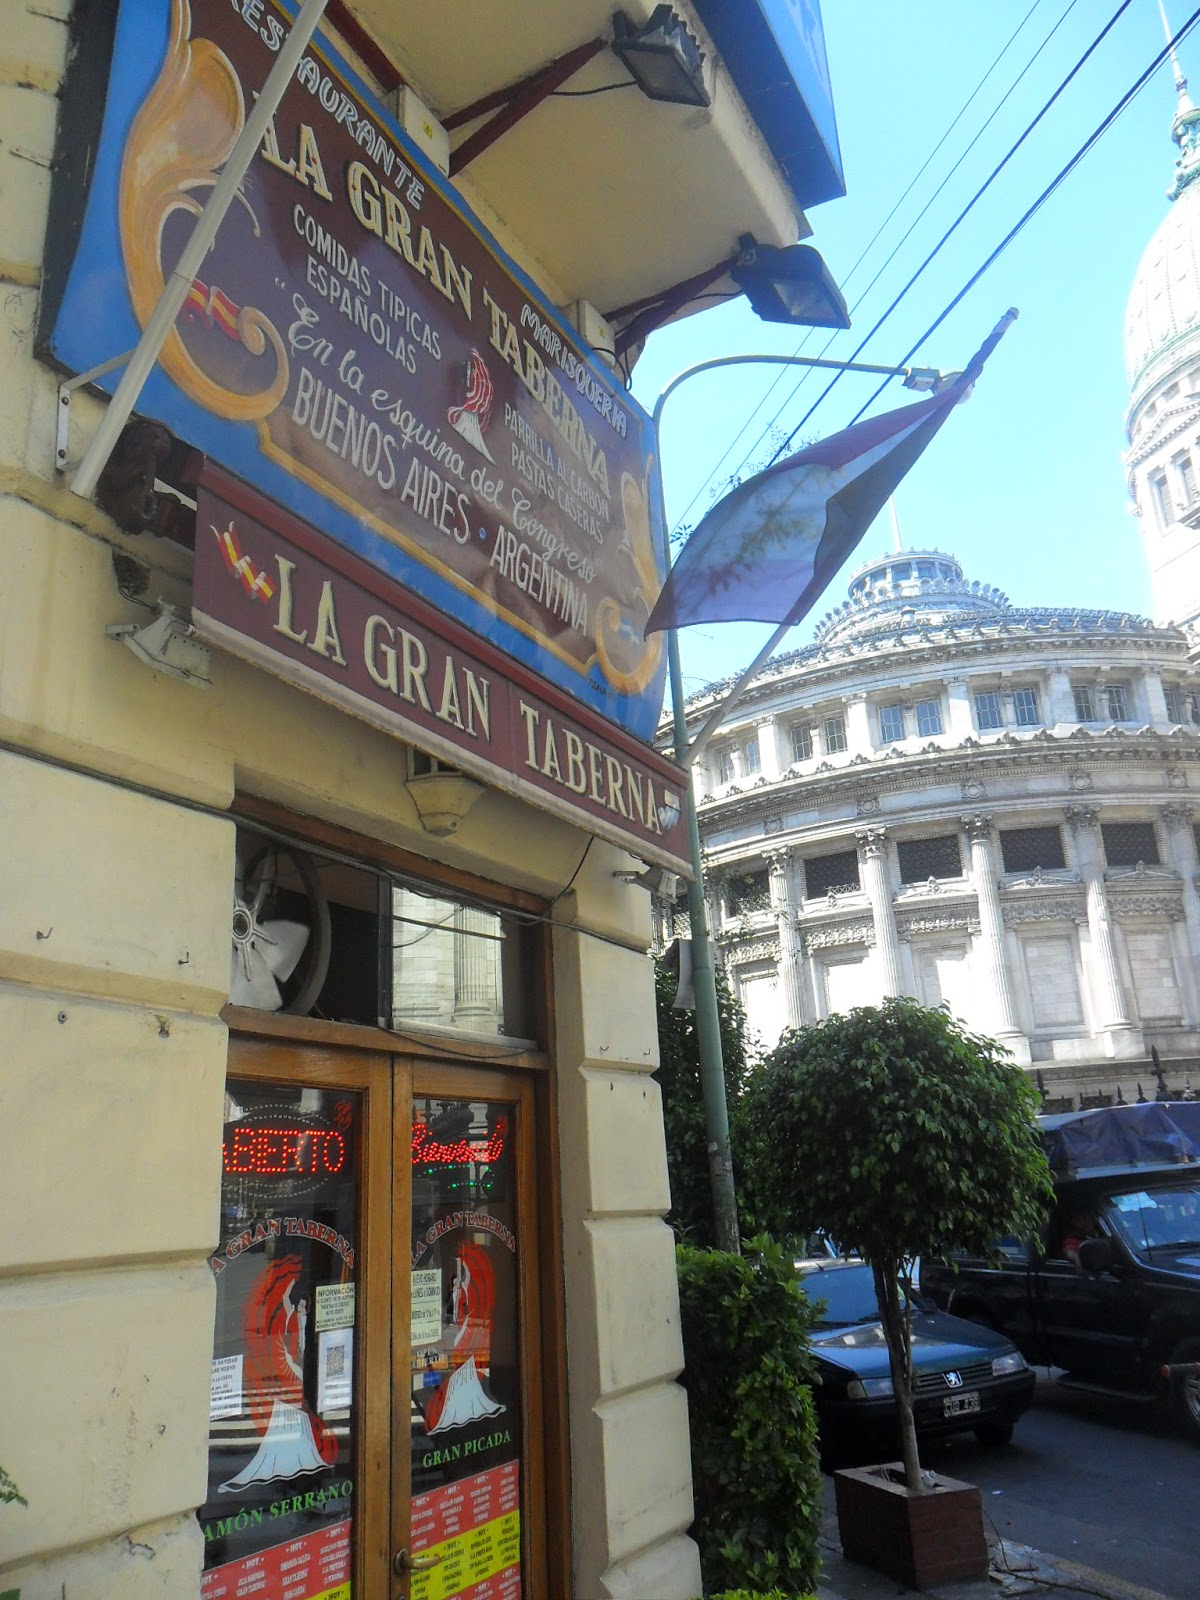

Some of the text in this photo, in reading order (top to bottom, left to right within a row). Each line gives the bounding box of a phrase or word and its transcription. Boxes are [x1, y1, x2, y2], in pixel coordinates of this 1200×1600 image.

[294, 203, 442, 361] COMIDAS TIPICAS
[306, 254, 418, 375] ESPAÑOLAS
[348, 160, 473, 321] GRAN
[483, 286, 611, 500] TABERNA
[338, 350, 363, 396] la
[371, 389, 466, 482] esquina
[470, 462, 504, 511] del
[511, 487, 596, 585] Congreso
[504, 402, 554, 472] PARRILLA
[557, 457, 569, 486] AL
[511, 442, 603, 545] PASTAS CASERAS
[293, 367, 588, 637] BUENOS AIRES ARGENTINA
[273, 554, 663, 837] LA GRAN TABERNA
[221, 1128, 344, 1174] BIERTO
[225, 1217, 282, 1260] GRAN
[284, 1217, 355, 1269] TABERNA
[425, 1211, 463, 1244] GRAN
[464, 1210, 516, 1253] TABERNA
[269, 1480, 354, 1520] SERRANO
[423, 1429, 511, 1468] GRAN PICADA
